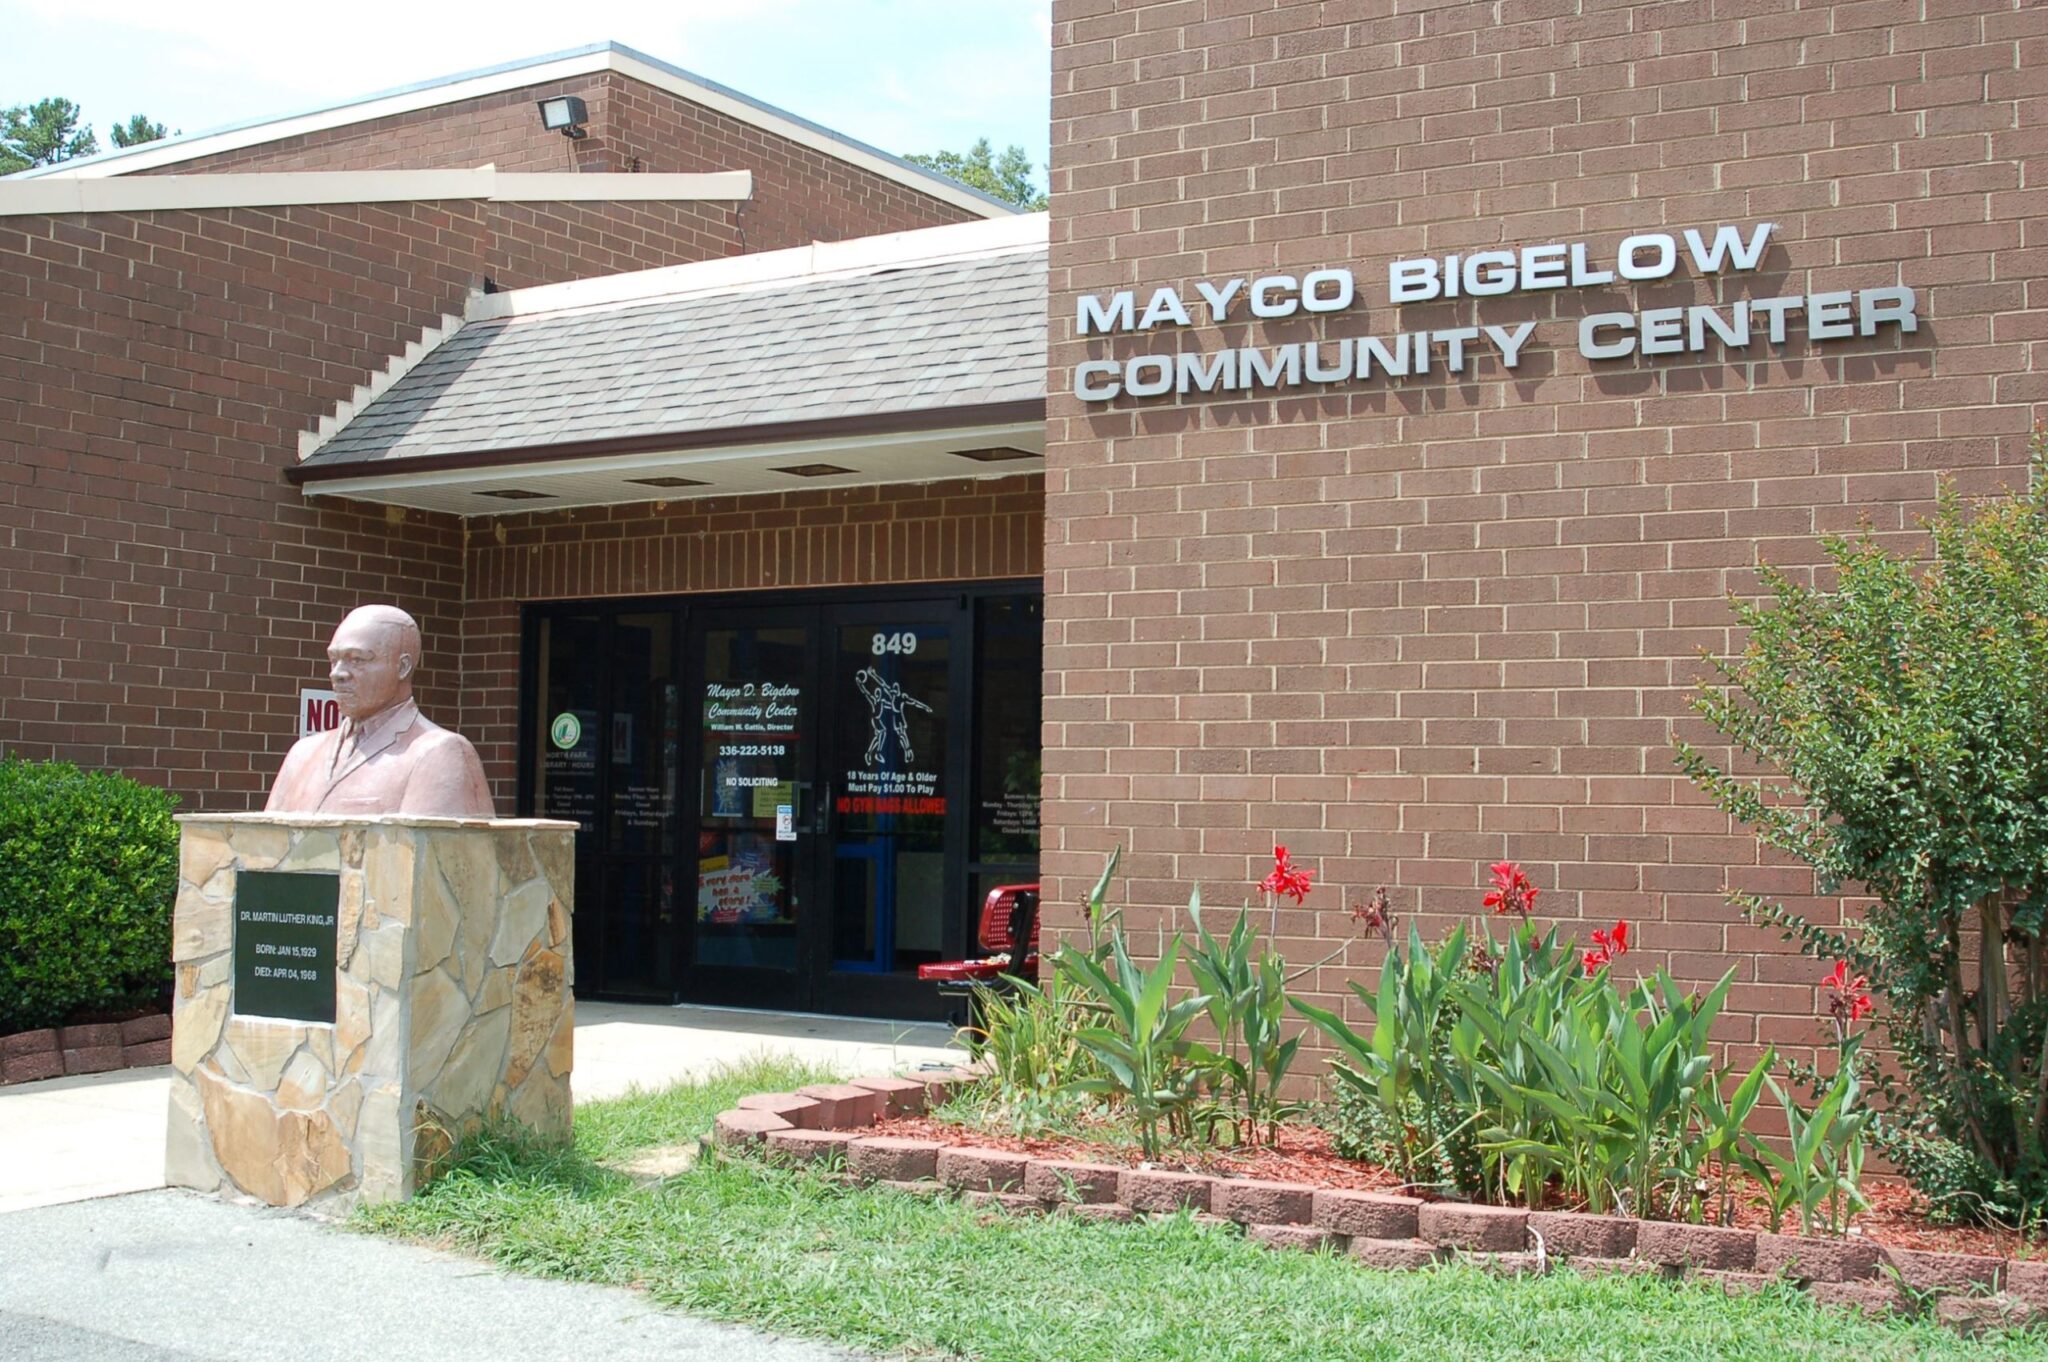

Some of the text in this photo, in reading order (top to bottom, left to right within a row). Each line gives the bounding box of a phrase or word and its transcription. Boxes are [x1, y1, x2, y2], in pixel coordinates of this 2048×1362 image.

[1076, 222, 1774, 336] MAYCO BIGELOW
[1074, 286, 1918, 403] COMMUNITY CENTER
[871, 632, 917, 655] 849
[707, 682, 800, 701] Mayco D. Bigelow
[306, 698, 339, 732] NO
[708, 702, 798, 720] Community Center
[719, 745, 785, 756] 336-222-5138
[726, 777, 779, 787] NO SOLICITING
[847, 771, 938, 783] 18 Years Of Age & Older
[848, 782, 935, 796] Must Pay $1.00 To Play
[837, 797, 851, 813] NO
[240, 911, 335, 926] DR. MARTIN LUTHER KING, JR
[255, 944, 277, 955] BORN:
[277, 945, 291, 956] JAN
[254, 966, 317, 981] DIED: APR 04, 1968
